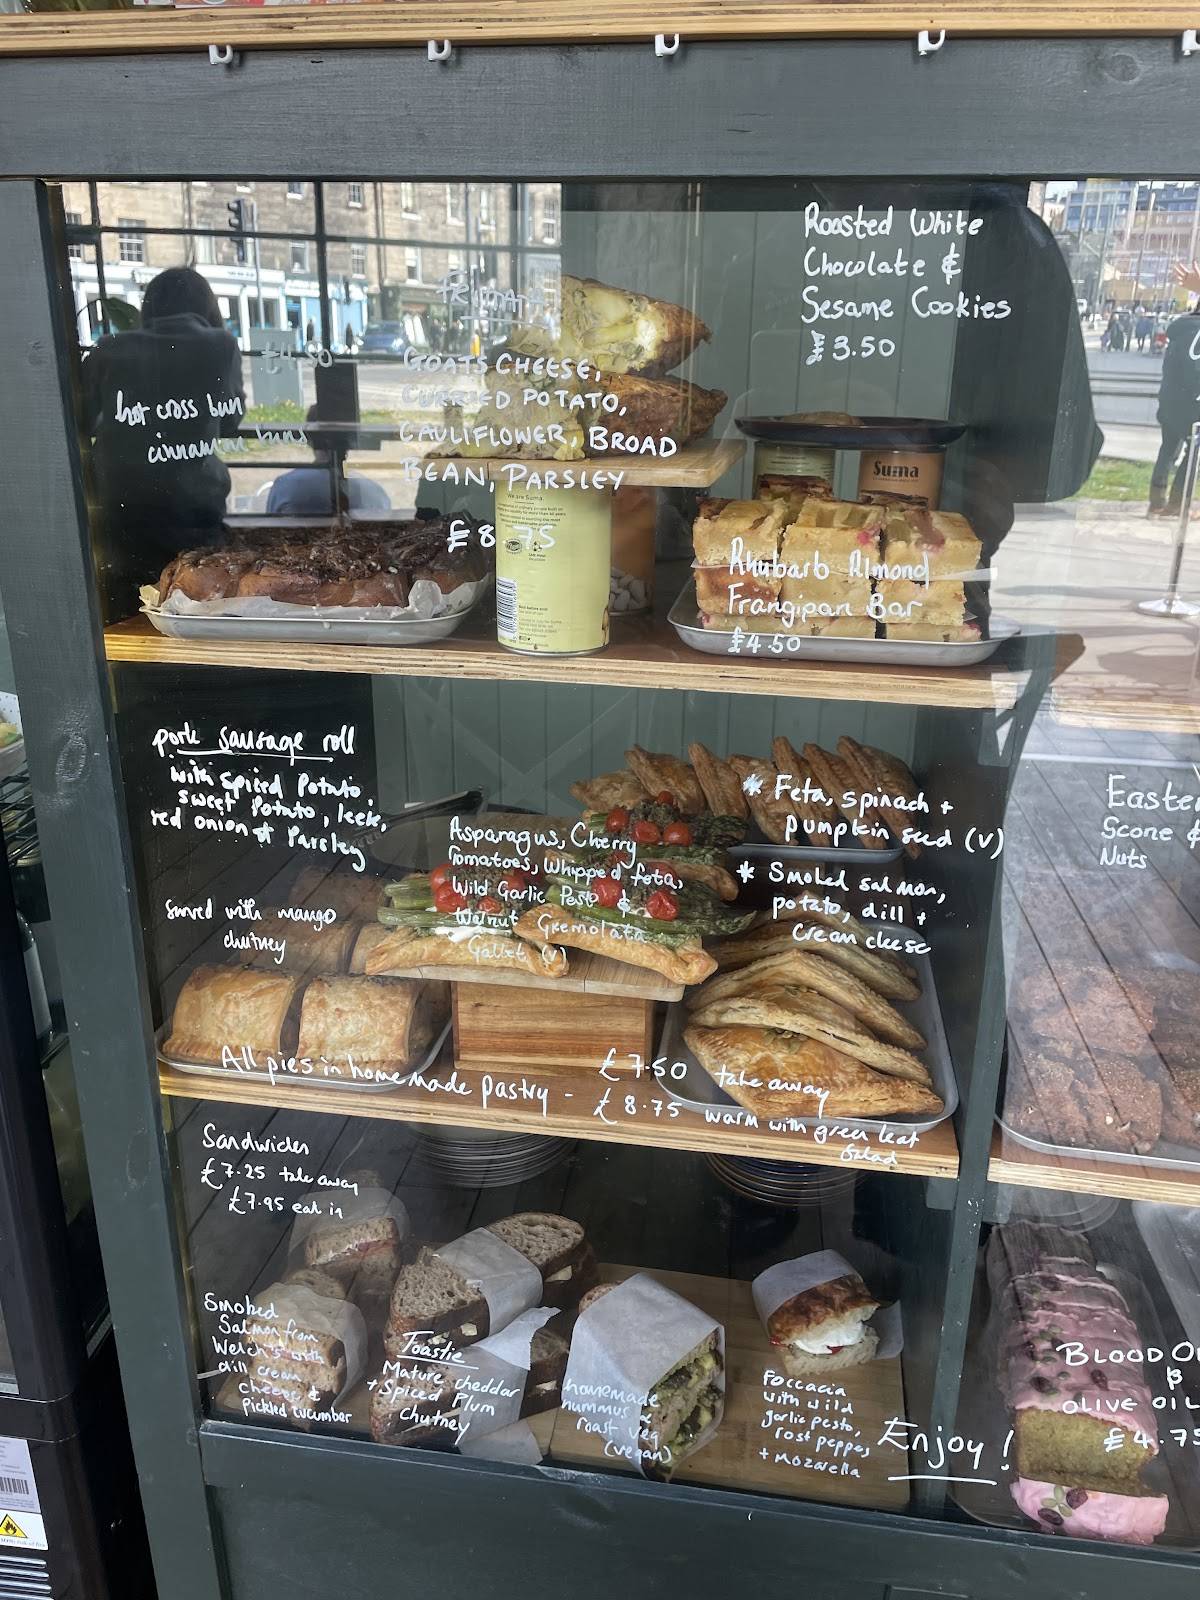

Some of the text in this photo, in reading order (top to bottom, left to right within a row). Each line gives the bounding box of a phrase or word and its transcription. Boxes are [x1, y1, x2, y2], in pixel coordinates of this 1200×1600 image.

[805, 201, 984, 239] Roasted White
[804, 242, 962, 285] Chocolate &
[801, 286, 1011, 324] Sesame Cookies
[404, 347, 602, 381] GOATS CHEESE,
[805, 330, 896, 365] £3.50
[115, 390, 243, 426] hot cross bun
[523, 389, 626, 416] POTATO,
[147, 432, 249, 463] cinnamon
[399, 423, 677, 457] CAULIFLOWER, BROAD
[400, 457, 625, 492] BEAN, PARSLEY
[873, 460, 919, 478] Suma
[729, 537, 930, 589] Rhubarb Almond
[728, 582, 923, 628] Frangipan Bar
[727, 627, 801, 654] £4.50
[323, 724, 355, 755] roll
[170, 760, 214, 786] with
[178, 789, 236, 812] sweet
[337, 799, 387, 833] leek,
[775, 774, 833, 806] Feta,
[841, 787, 929, 818] spinach
[150, 806, 182, 830] red
[194, 811, 248, 837] onion
[785, 814, 889, 847] pumpkin
[902, 828, 952, 848] seed
[1101, 816, 1174, 840] Scone
[449, 815, 637, 870] Asparagus, Cherry
[1100, 845, 1147, 869] Nuts
[448, 845, 538, 875] Tomatoes,
[544, 857, 621, 884] Whipped
[452, 876, 488, 897] Wild
[498, 882, 546, 904] Garlic
[560, 885, 599, 908] Pesto
[225, 898, 262, 920] with
[278, 906, 337, 931] mango
[454, 907, 647, 943] Walnut Gremolata
[773, 896, 850, 924] potato,
[862, 903, 903, 924] dill
[223, 929, 286, 965] chutney
[866, 932, 931, 954] cheese
[222, 1046, 257, 1073] All
[267, 1052, 313, 1086] pies
[321, 1056, 342, 1076] in
[713, 1064, 763, 1089] take
[768, 1078, 831, 1119] away
[768, 1118, 807, 1135] with
[814, 1124, 869, 1145] green
[879, 1123, 920, 1148] leaf
[201, 1157, 359, 1197] £7.25 take away
[228, 1186, 344, 1219] £7.95 eat in
[203, 1292, 279, 1319] Smoked
[218, 1313, 319, 1347] Salmon from
[402, 1330, 466, 1364] Toastie
[1056, 1341, 1200, 1366] BLOOD O
[218, 1360, 302, 1382] dill cream
[382, 1359, 444, 1385] Mature
[451, 1393, 496, 1416] Plum
[563, 1379, 660, 1408] homemade
[763, 1392, 853, 1415] with wild
[1062, 1396, 1200, 1414] OLIVE OIL
[293, 1406, 353, 1424] cucumber
[761, 1410, 861, 1437] garlic pesto,
[576, 1416, 659, 1450] roast veg
[877, 1417, 984, 1470] Enjoy
[1104, 1428, 1200, 1452] £4.75
[604, 1440, 672, 1464] (vegan)
